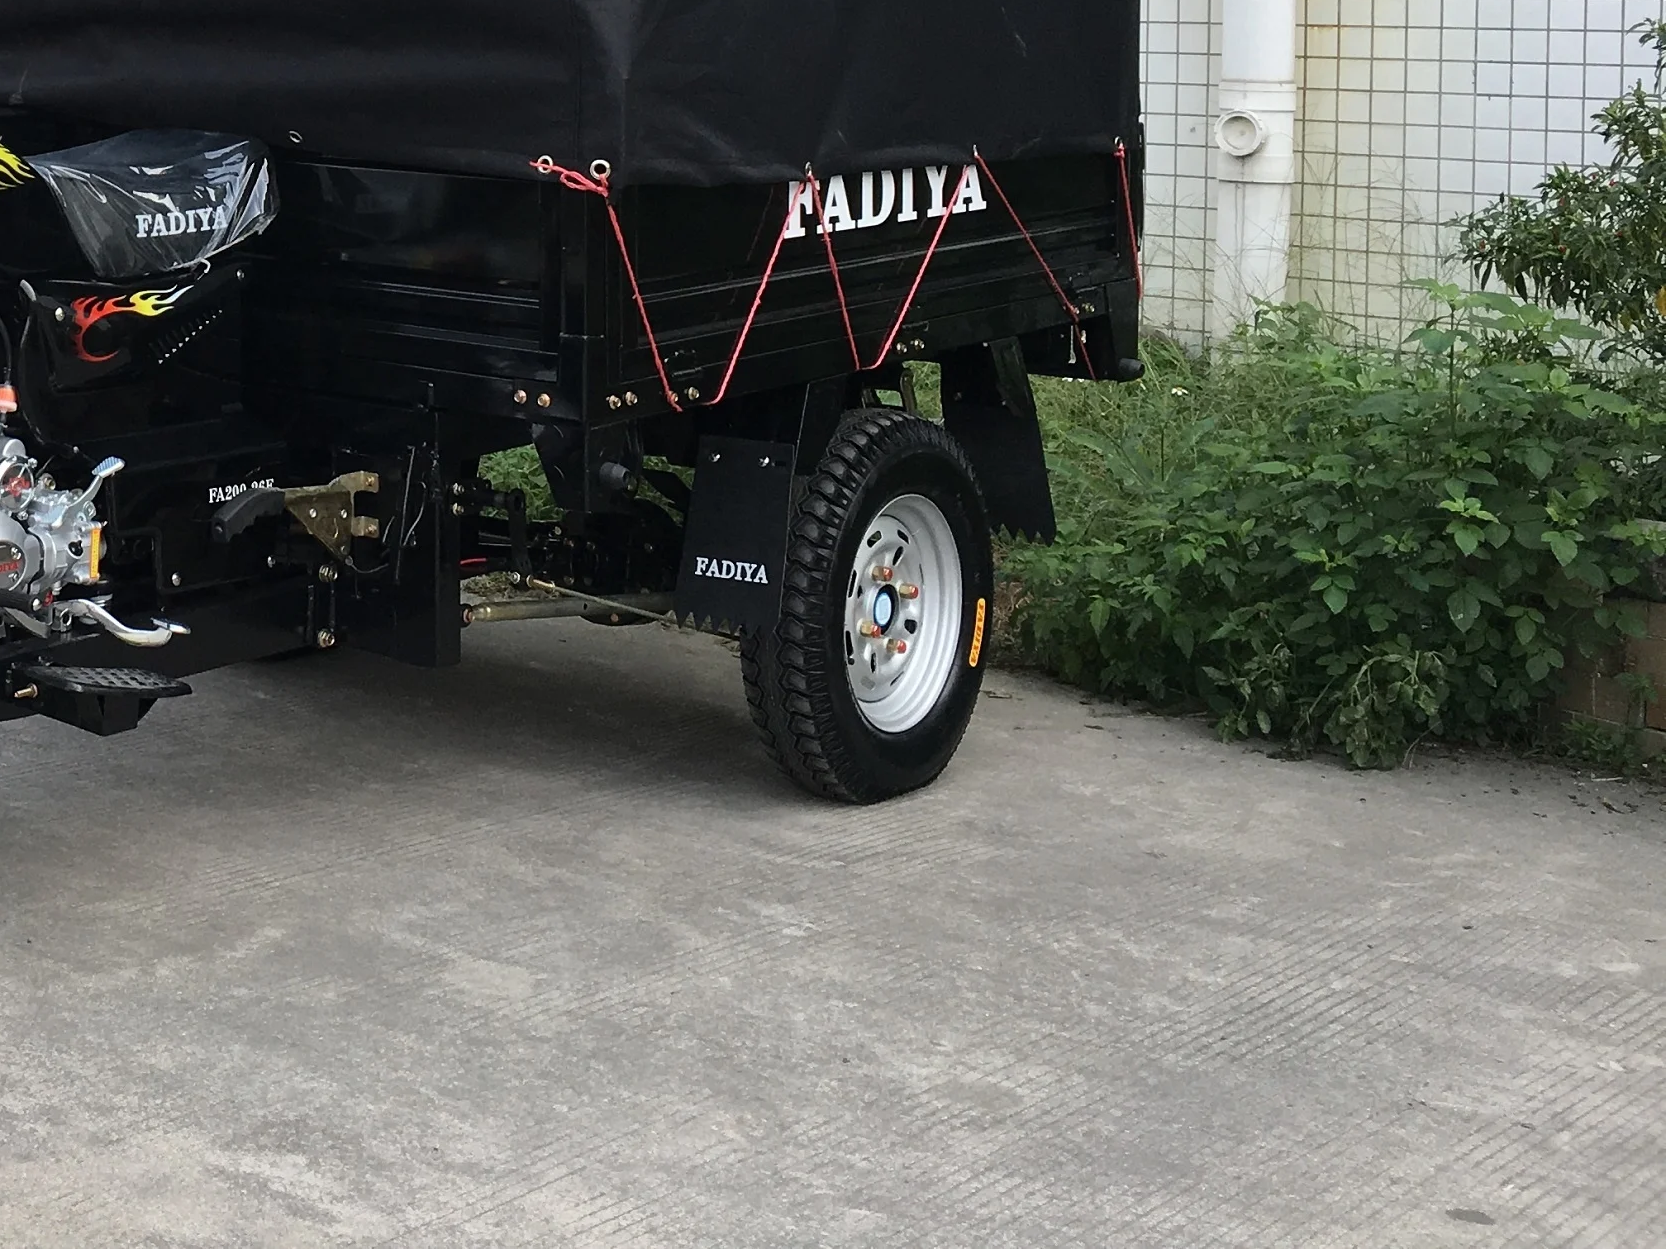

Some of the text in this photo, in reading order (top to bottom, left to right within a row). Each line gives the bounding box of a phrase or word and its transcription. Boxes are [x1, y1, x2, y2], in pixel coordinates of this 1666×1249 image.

[784, 165, 987, 239] FADIYA
[135, 205, 228, 238] FADIYA
[694, 556, 769, 584] FADIYA
